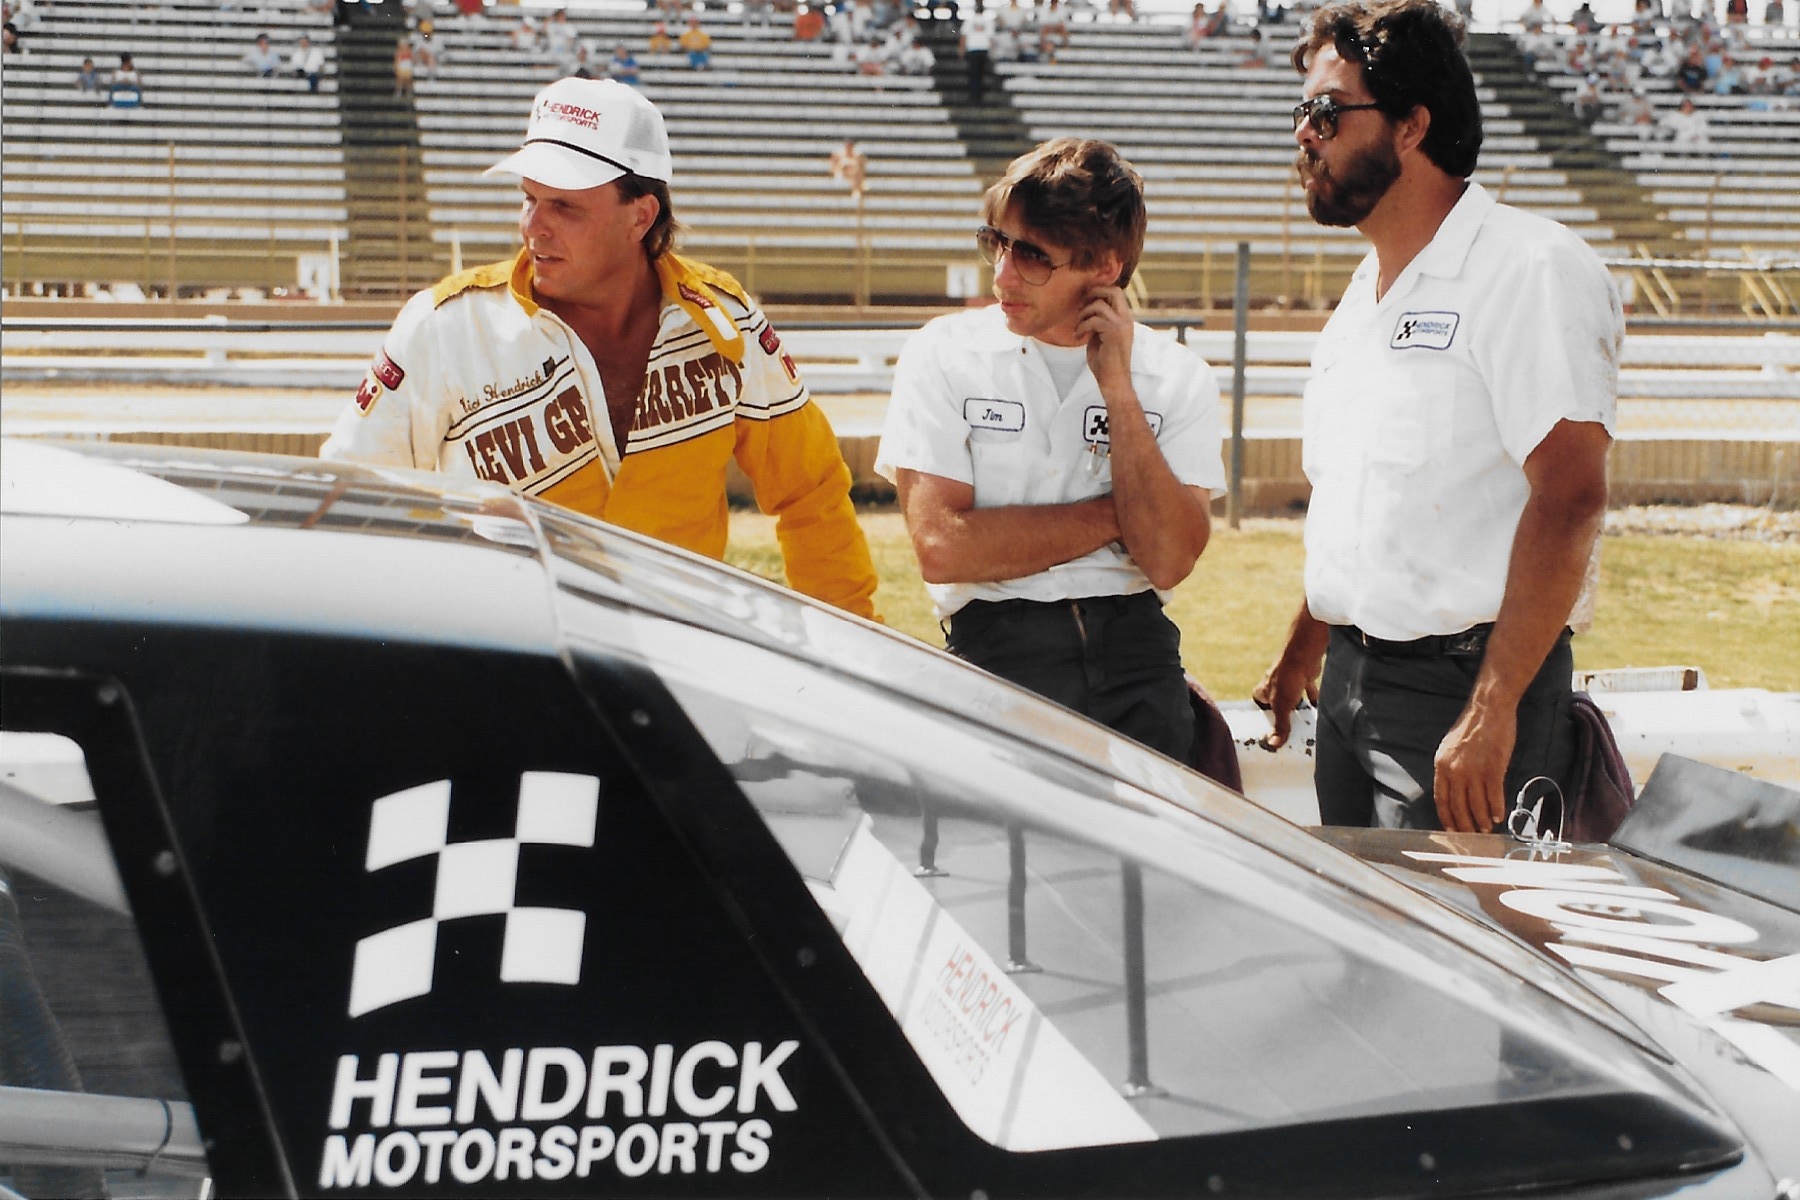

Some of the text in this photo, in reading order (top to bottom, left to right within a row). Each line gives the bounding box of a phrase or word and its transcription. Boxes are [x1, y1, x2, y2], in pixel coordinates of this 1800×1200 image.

[483, 370, 543, 402] Hendrick
[982, 408, 1003, 422] Jim
[464, 414, 548, 485] LEVI
[936, 943, 1023, 1056] HENDRICK
[328, 1040, 800, 1130] HENDRICK
[319, 1118, 773, 1189] MOTORSPORTS
